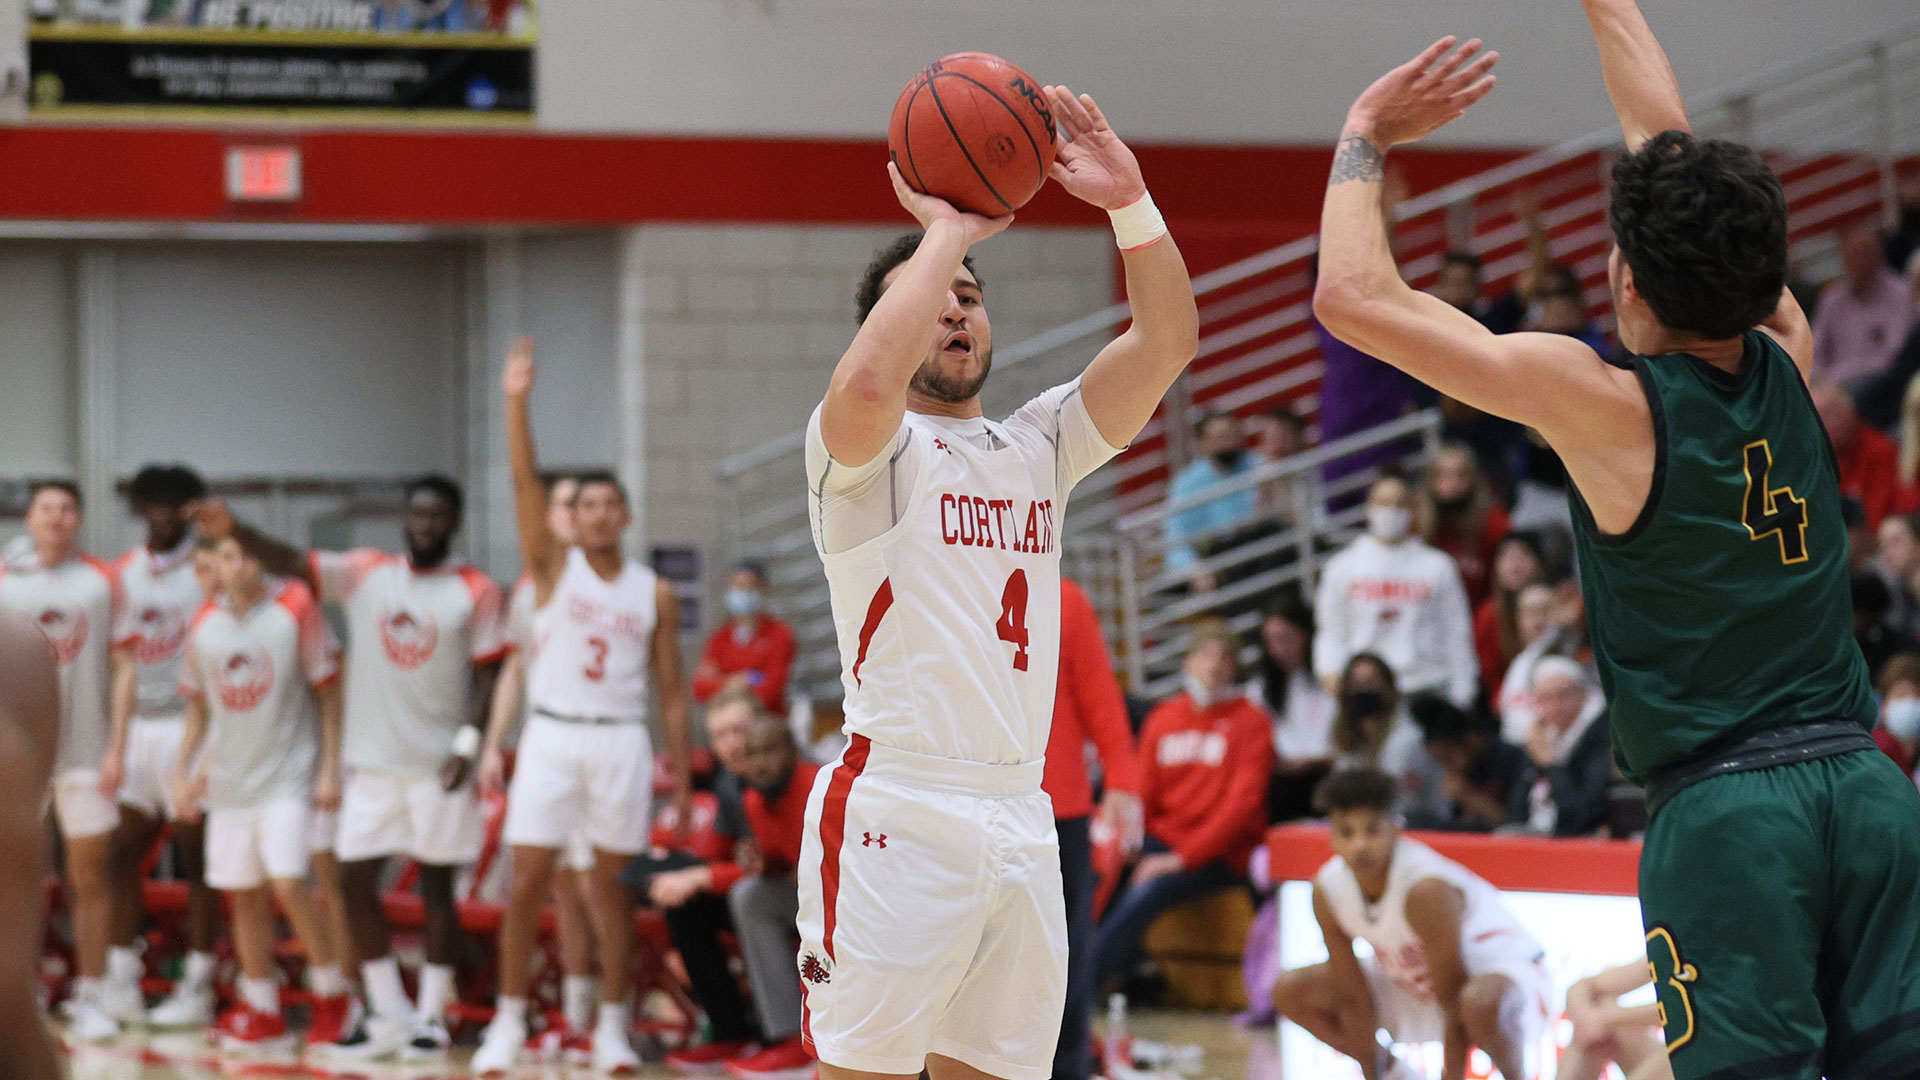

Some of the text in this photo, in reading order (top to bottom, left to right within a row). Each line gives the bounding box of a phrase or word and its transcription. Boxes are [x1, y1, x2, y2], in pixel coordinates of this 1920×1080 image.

[1010, 77, 1057, 145] NCAA
[940, 493, 1054, 554] CORTLAN
[1741, 439, 1809, 565] 4
[995, 568, 1029, 672] 4
[583, 636, 609, 682] 3
